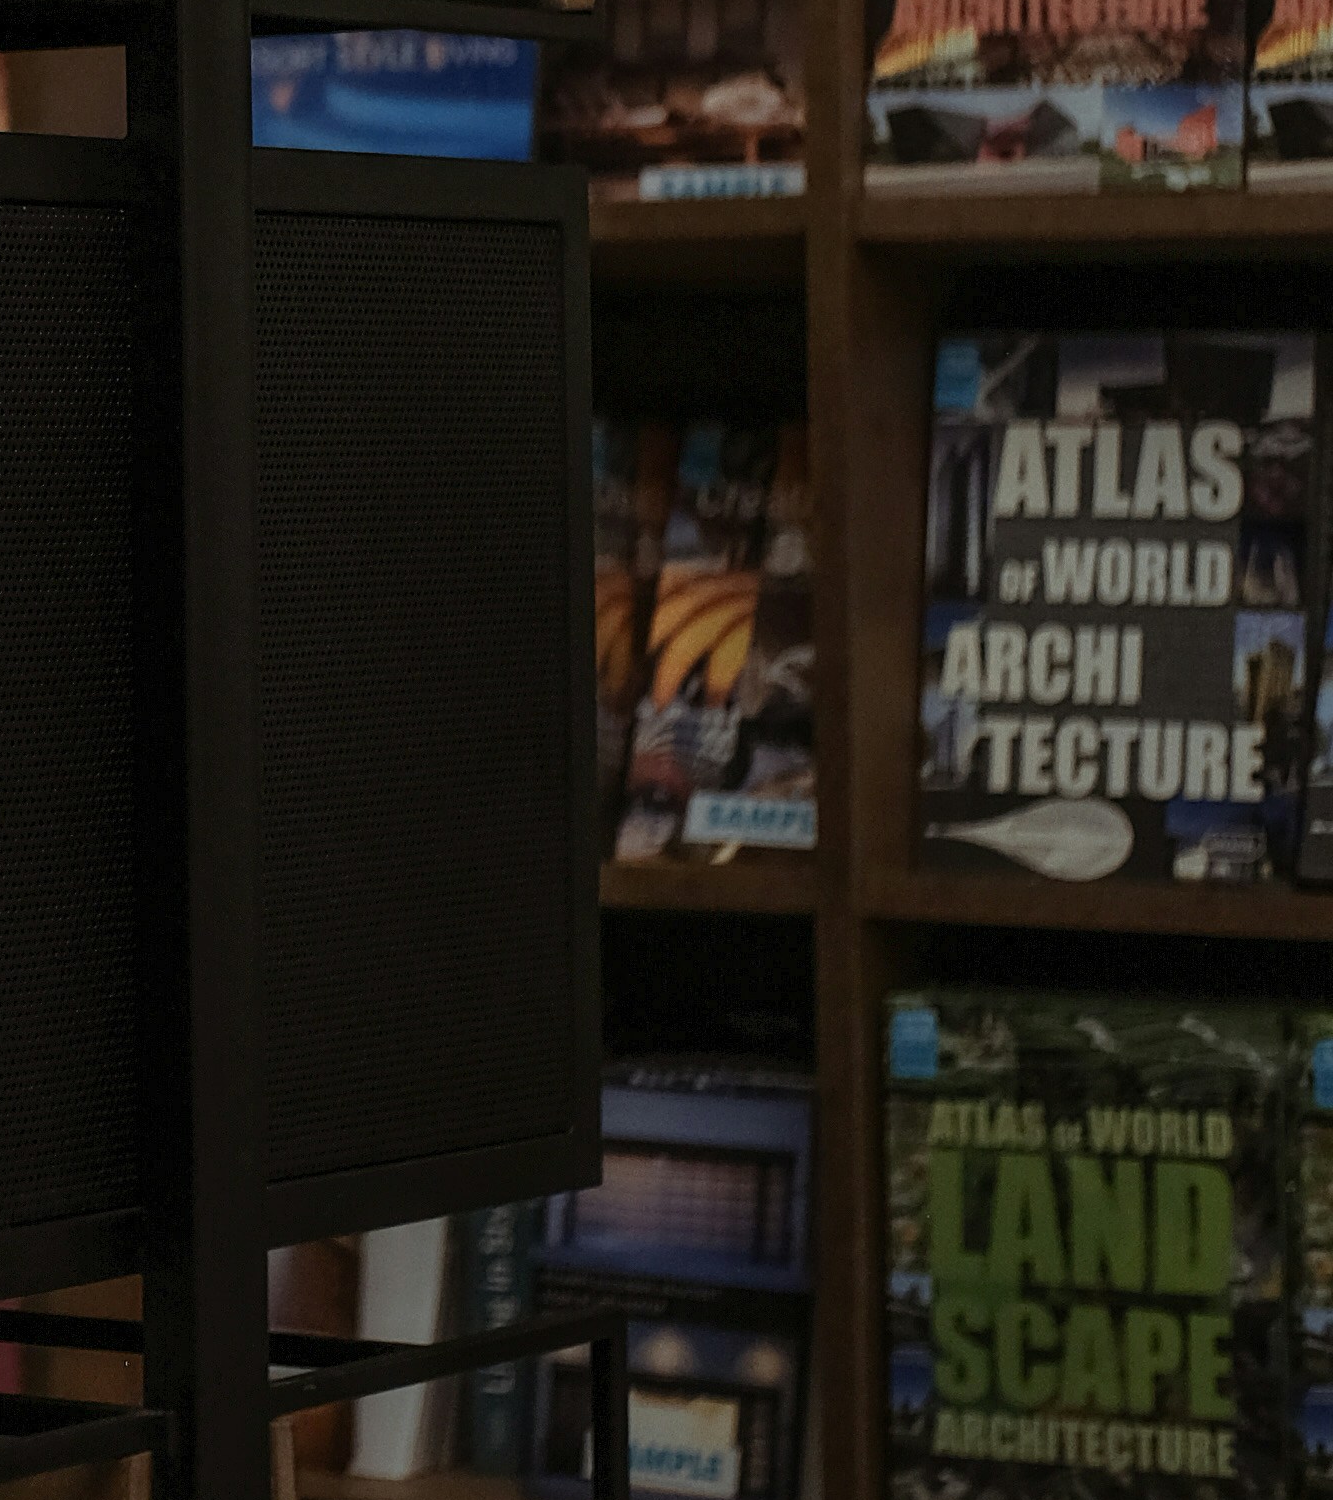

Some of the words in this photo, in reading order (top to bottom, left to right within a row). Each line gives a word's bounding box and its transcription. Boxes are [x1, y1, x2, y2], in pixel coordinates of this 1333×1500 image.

[995, 419, 1244, 522] ATLAS
[1042, 537, 1232, 608] WORLD
[939, 621, 1144, 706] ARCHI
[978, 714, 1267, 802] TECTURE
[927, 1103, 1046, 1149] ATLAS
[1086, 1108, 1234, 1160] WORLD
[930, 1148, 1234, 1294] LAND
[931, 1300, 1236, 1419] SCAPE
[935, 1408, 1237, 1479] ARCHITECTURE
